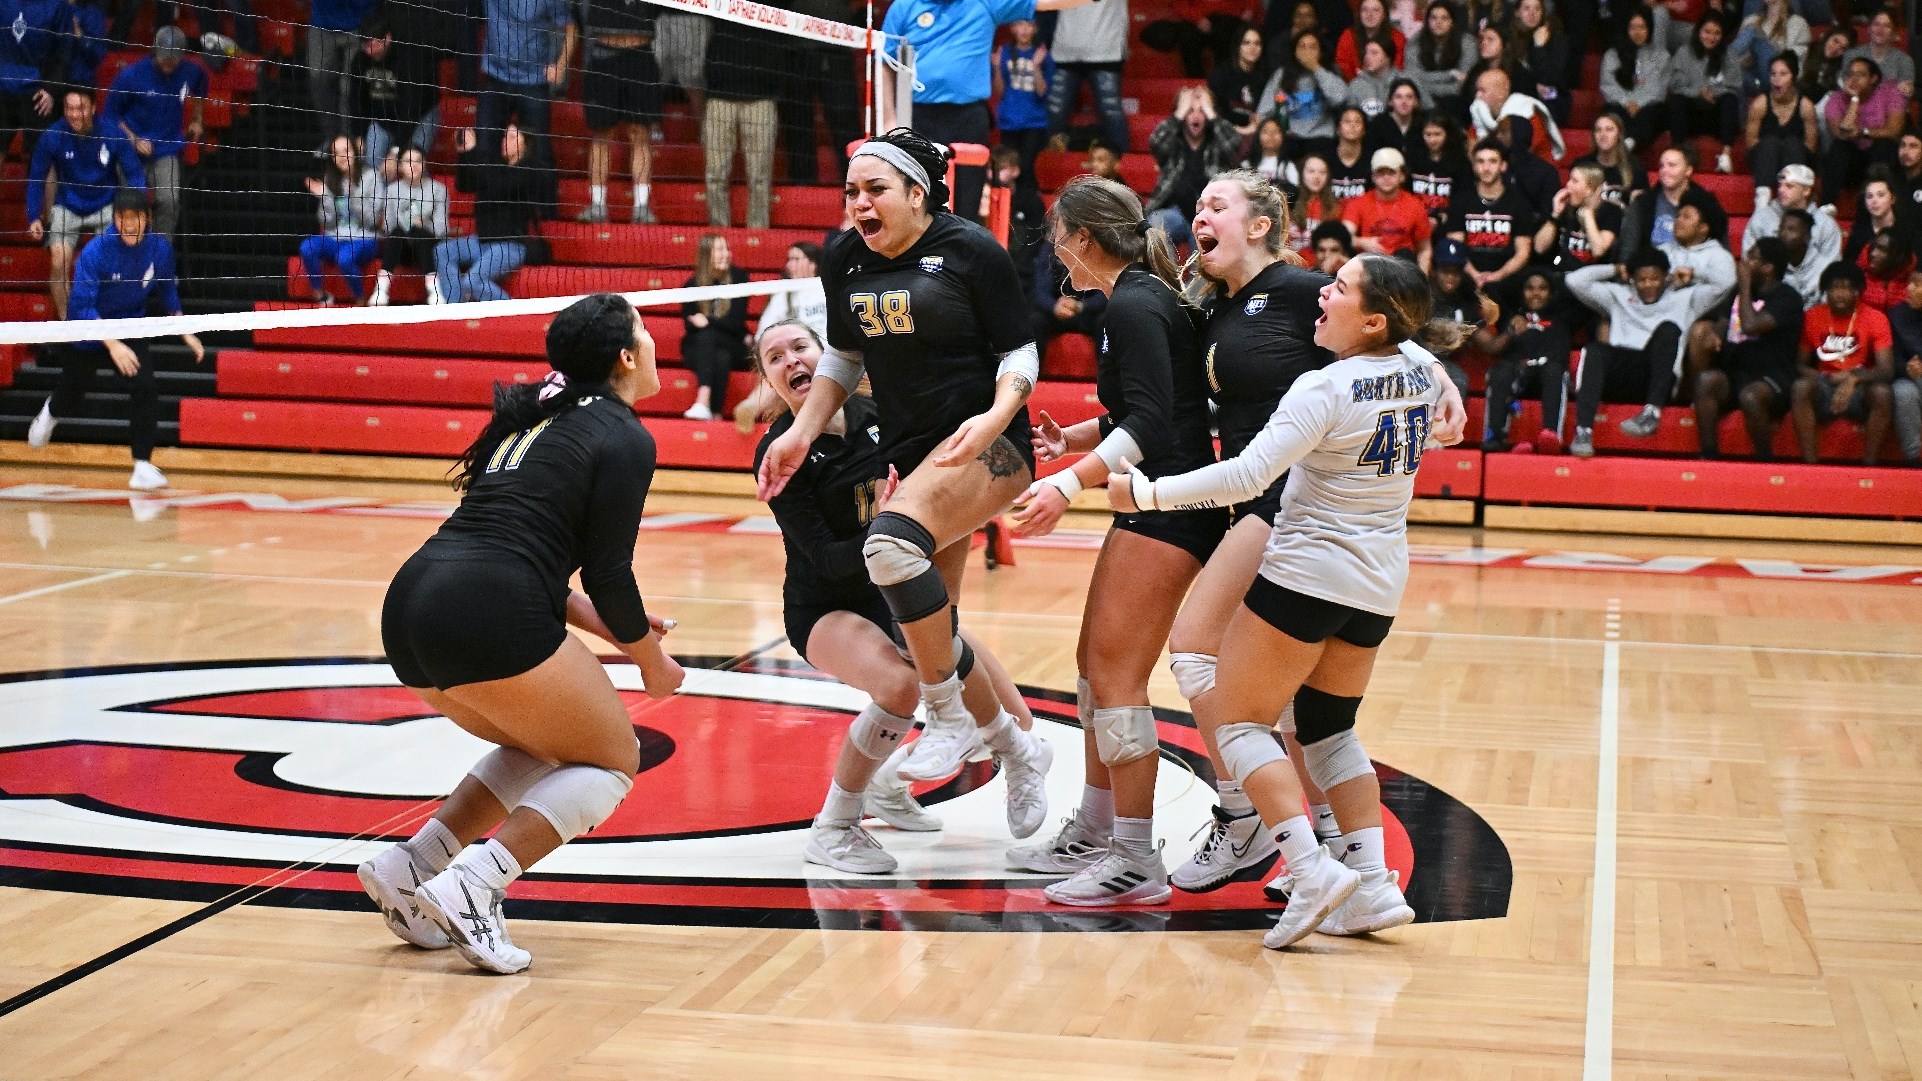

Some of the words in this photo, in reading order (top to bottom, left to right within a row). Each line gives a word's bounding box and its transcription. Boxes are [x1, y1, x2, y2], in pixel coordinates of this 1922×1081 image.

[849, 289, 915, 338] 38
[1351, 372, 1405, 403] NORTH
[485, 413, 557, 474] 11
[1356, 404, 1431, 478] 40
